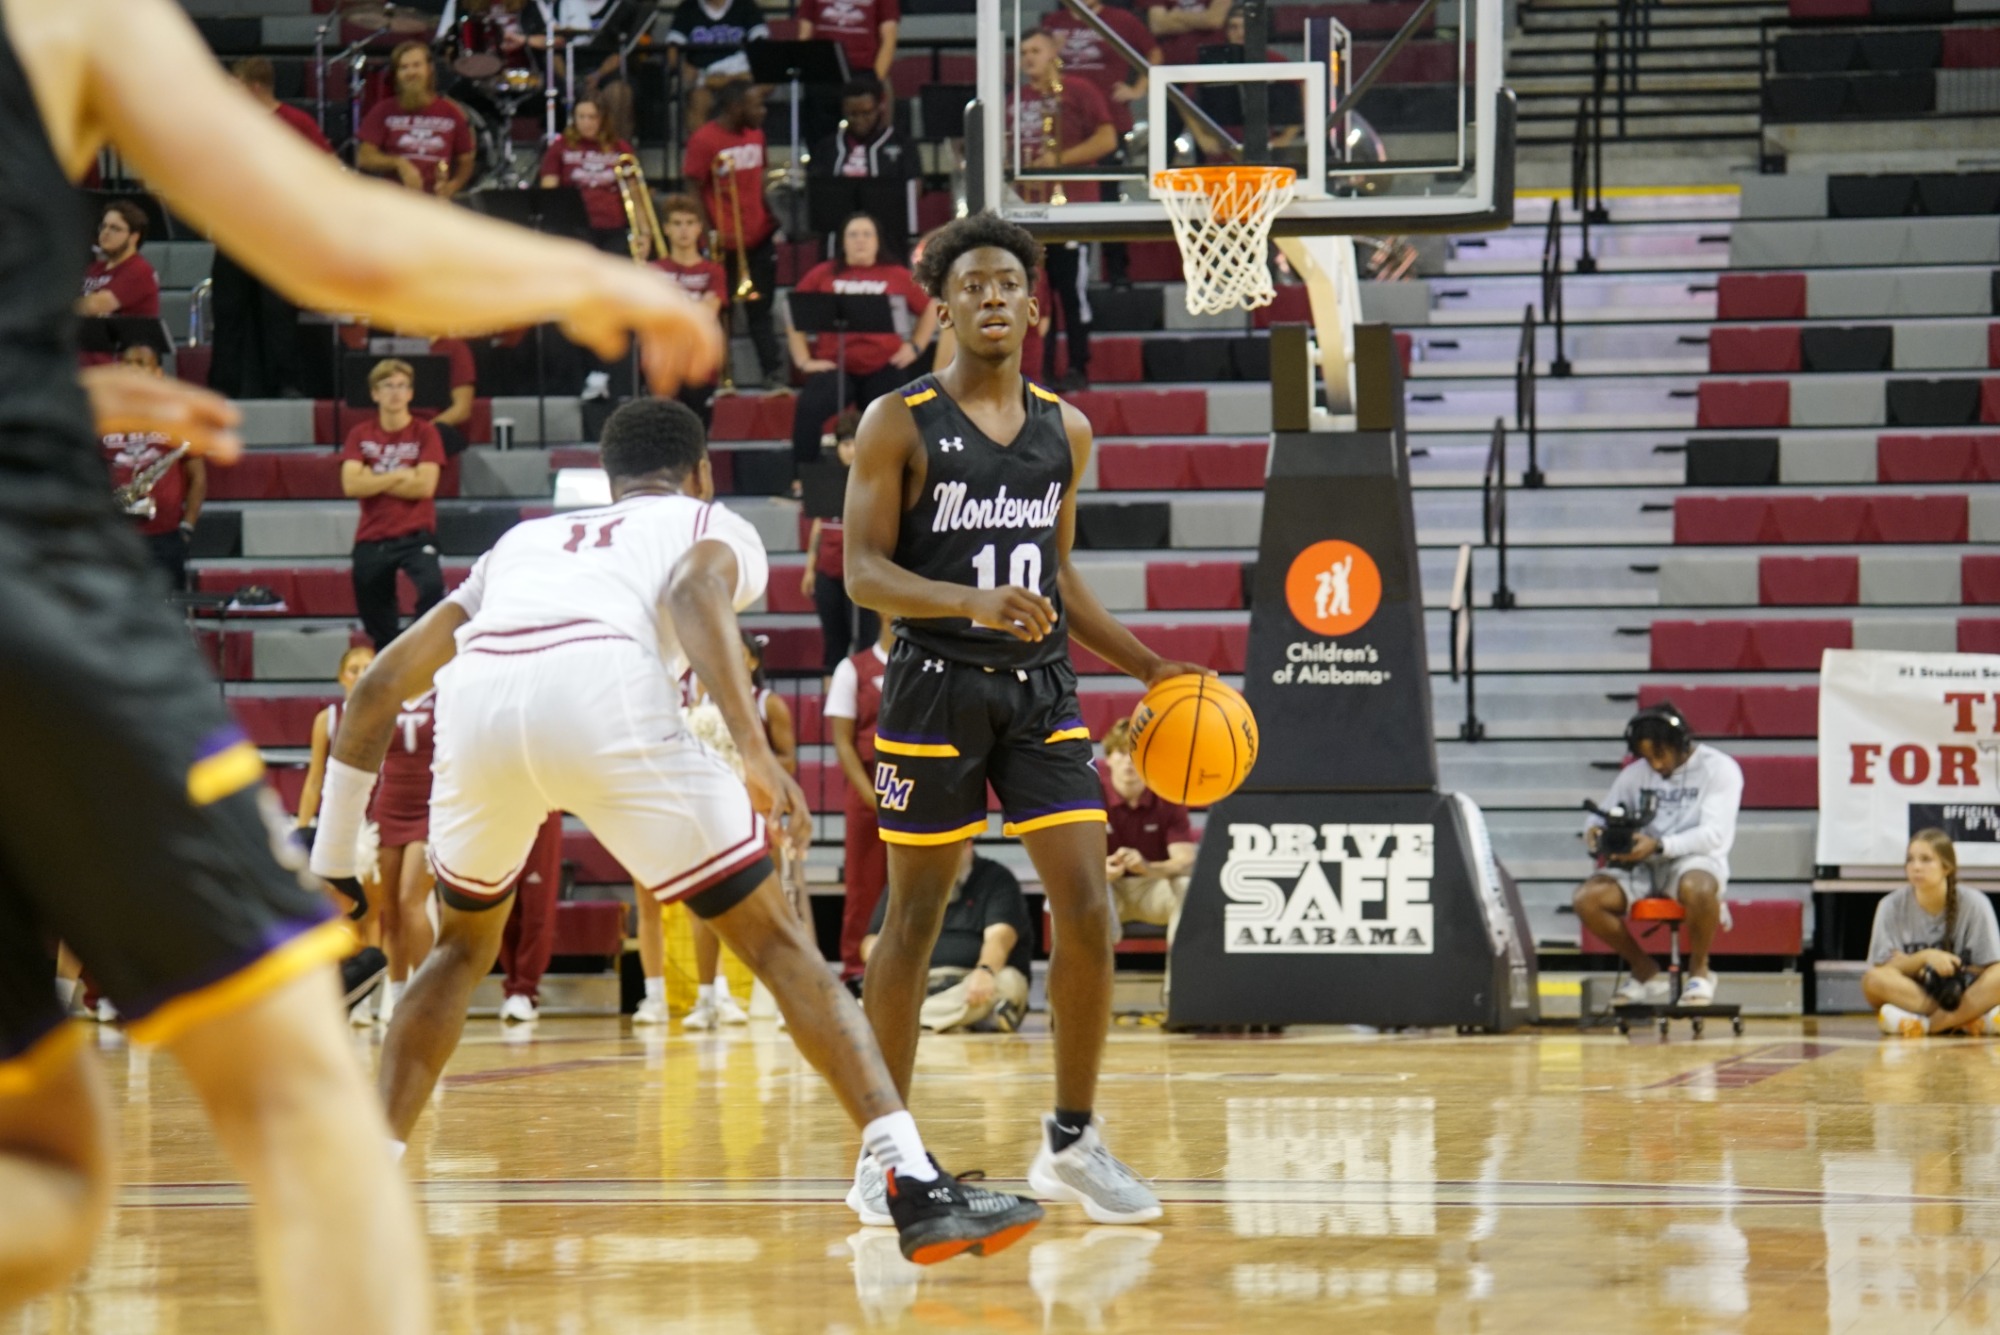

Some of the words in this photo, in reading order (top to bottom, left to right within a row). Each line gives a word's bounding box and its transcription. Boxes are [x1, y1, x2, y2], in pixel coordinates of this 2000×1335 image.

[932, 480, 1062, 533] Montevall
[563, 517, 625, 553] 11
[971, 542, 1042, 612] 10
[1286, 641, 1379, 663] Children's
[1272, 662, 1294, 685] of
[1297, 663, 1383, 685] Alabama
[1920, 667, 1977, 678] Student
[1944, 693, 2000, 733] T
[875, 762, 915, 812] UM
[1227, 823, 1435, 862] DRIVE
[1219, 857, 1435, 922] SAFE
[1233, 926, 1427, 947] ALABAMA
